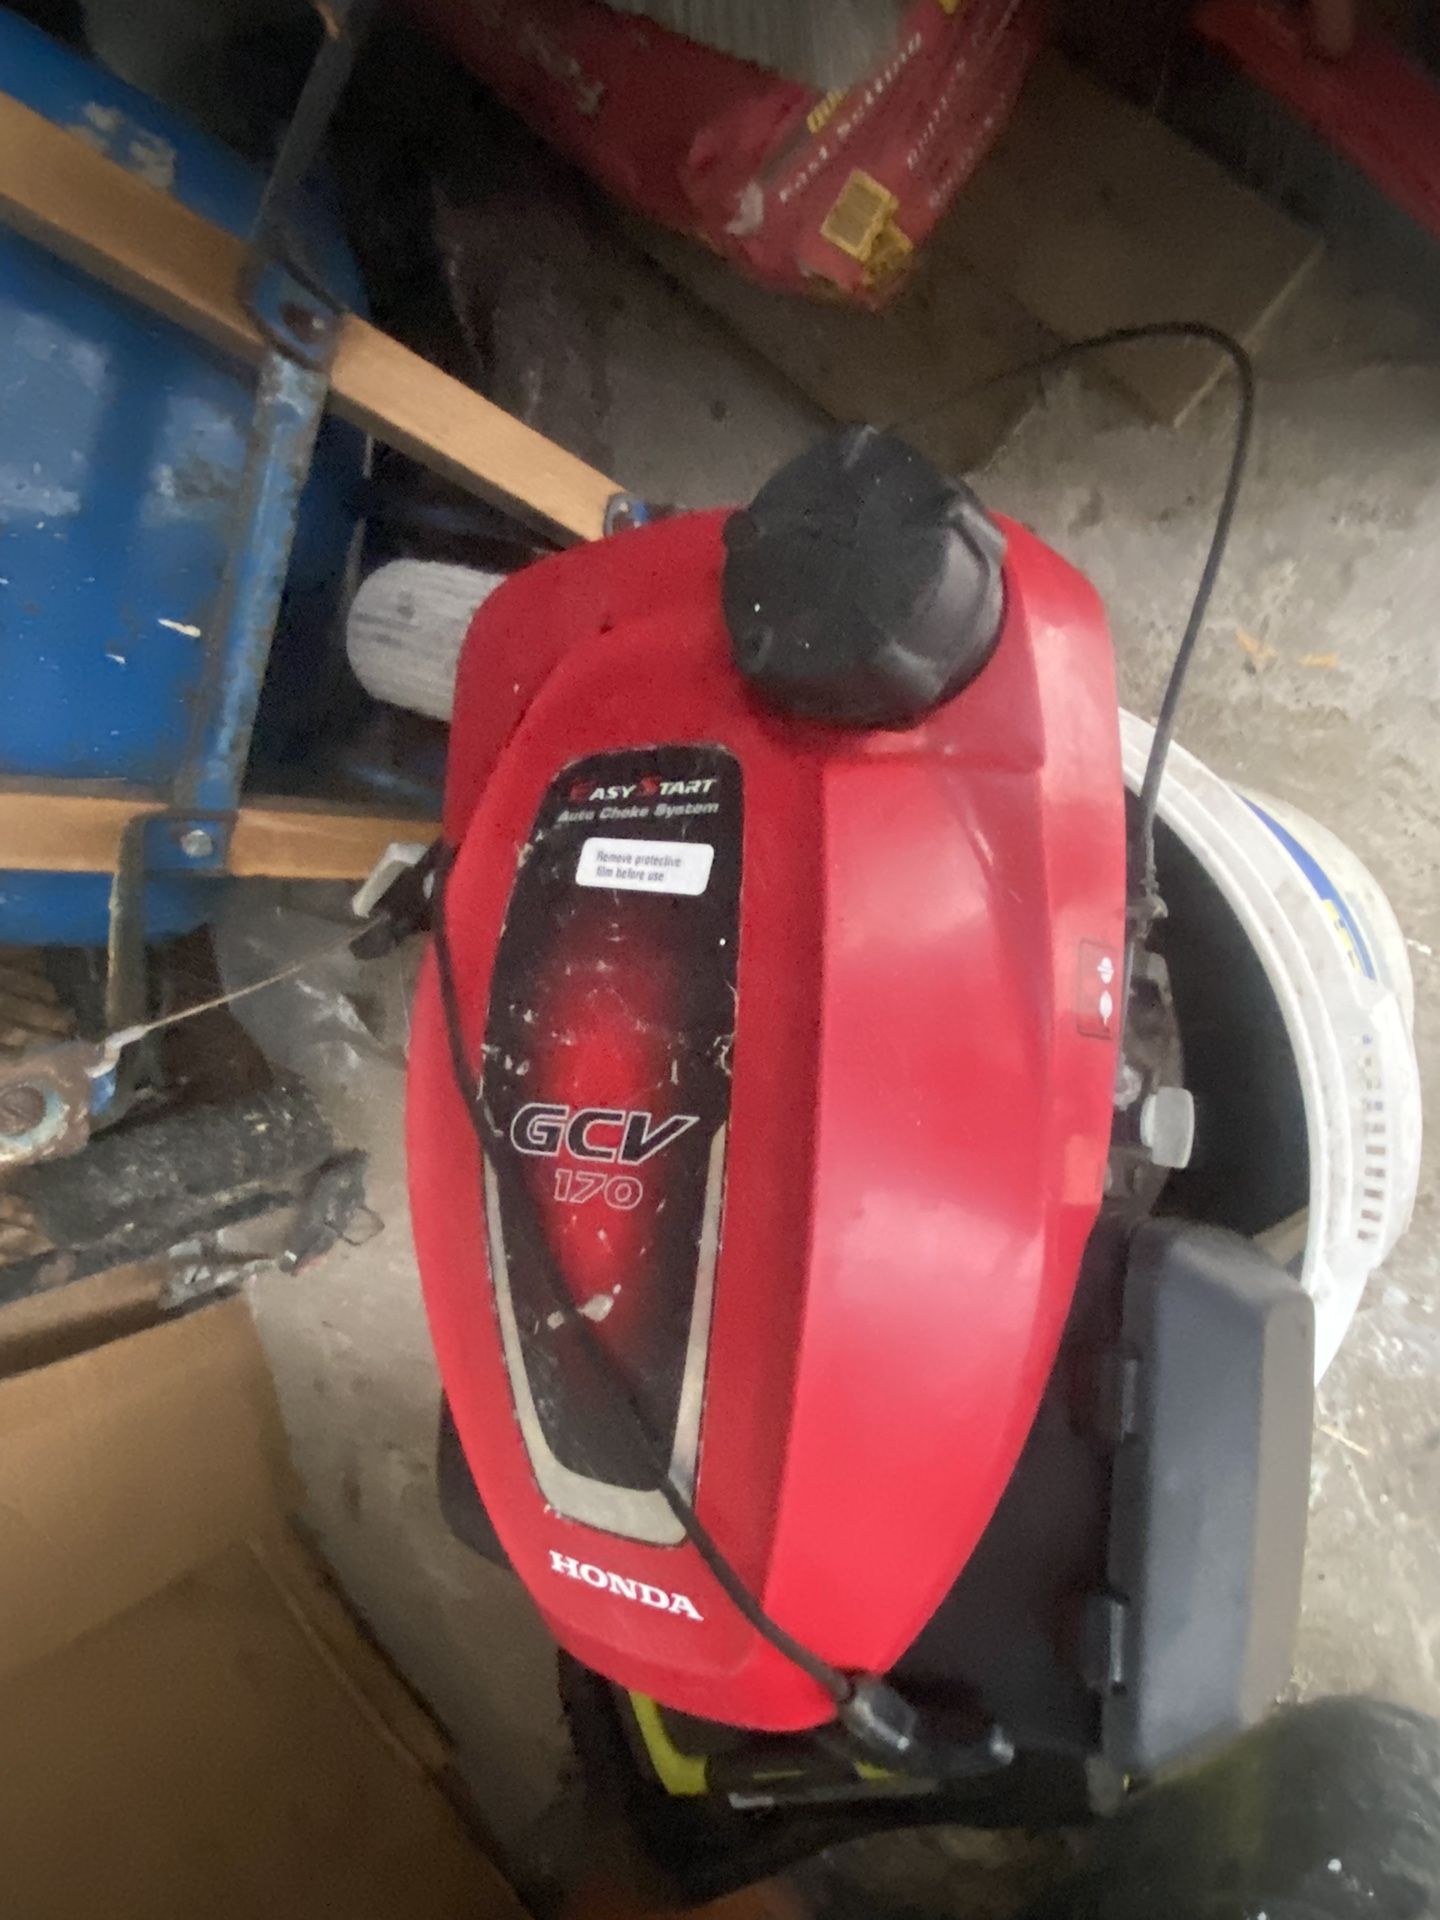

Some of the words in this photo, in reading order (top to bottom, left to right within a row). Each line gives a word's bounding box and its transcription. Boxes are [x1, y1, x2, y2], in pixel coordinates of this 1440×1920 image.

[557, 810, 595, 824] Auto
[599, 805, 650, 821] Choke
[654, 802, 721, 819] System
[596, 850, 632, 865] Remove
[634, 855, 682, 868] protective
[596, 865, 614, 878] film
[616, 867, 645, 881] before
[647, 871, 665, 882] use
[510, 1102, 700, 1166] GCV
[554, 1168, 644, 1210] 170
[549, 1549, 704, 1621] HONDA
